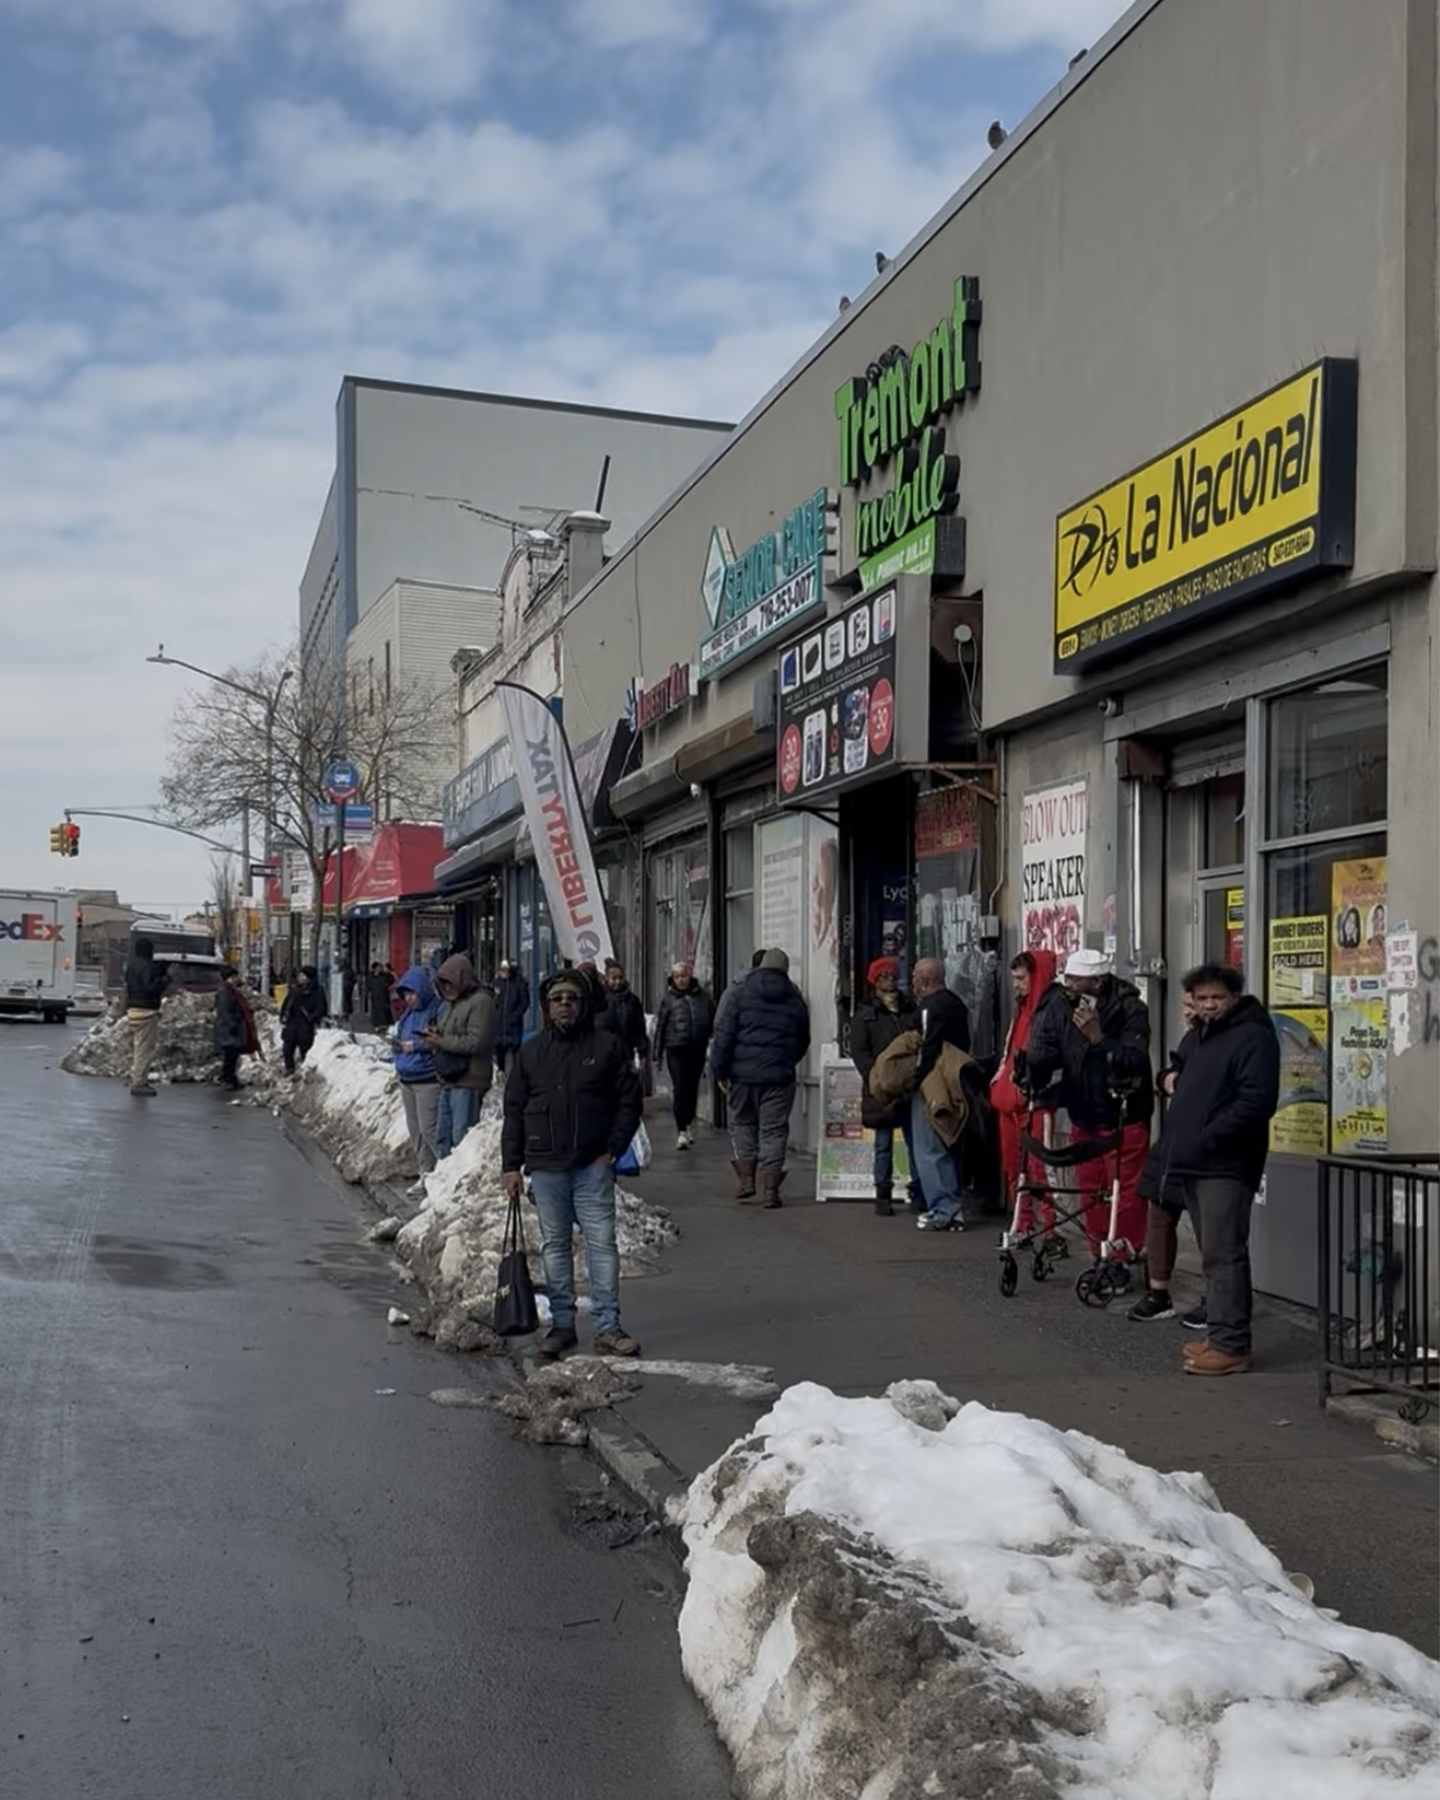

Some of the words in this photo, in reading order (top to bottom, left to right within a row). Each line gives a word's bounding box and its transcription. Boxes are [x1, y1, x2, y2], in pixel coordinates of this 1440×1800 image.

[834, 275, 968, 487] Tremont
[854, 425, 948, 557] mobile
[1125, 481, 1161, 570] La
[1167, 375, 1319, 551] Nacional
[726, 532, 775, 621] SENIOR
[782, 487, 825, 577] CARE
[1023, 799, 1057, 846] BLOW
[1060, 791, 1086, 838] OUT
[1023, 854, 1085, 904] SPEAKER
[1274, 954, 1297, 967] SOLD
[1299, 953, 1323, 966] HERE
